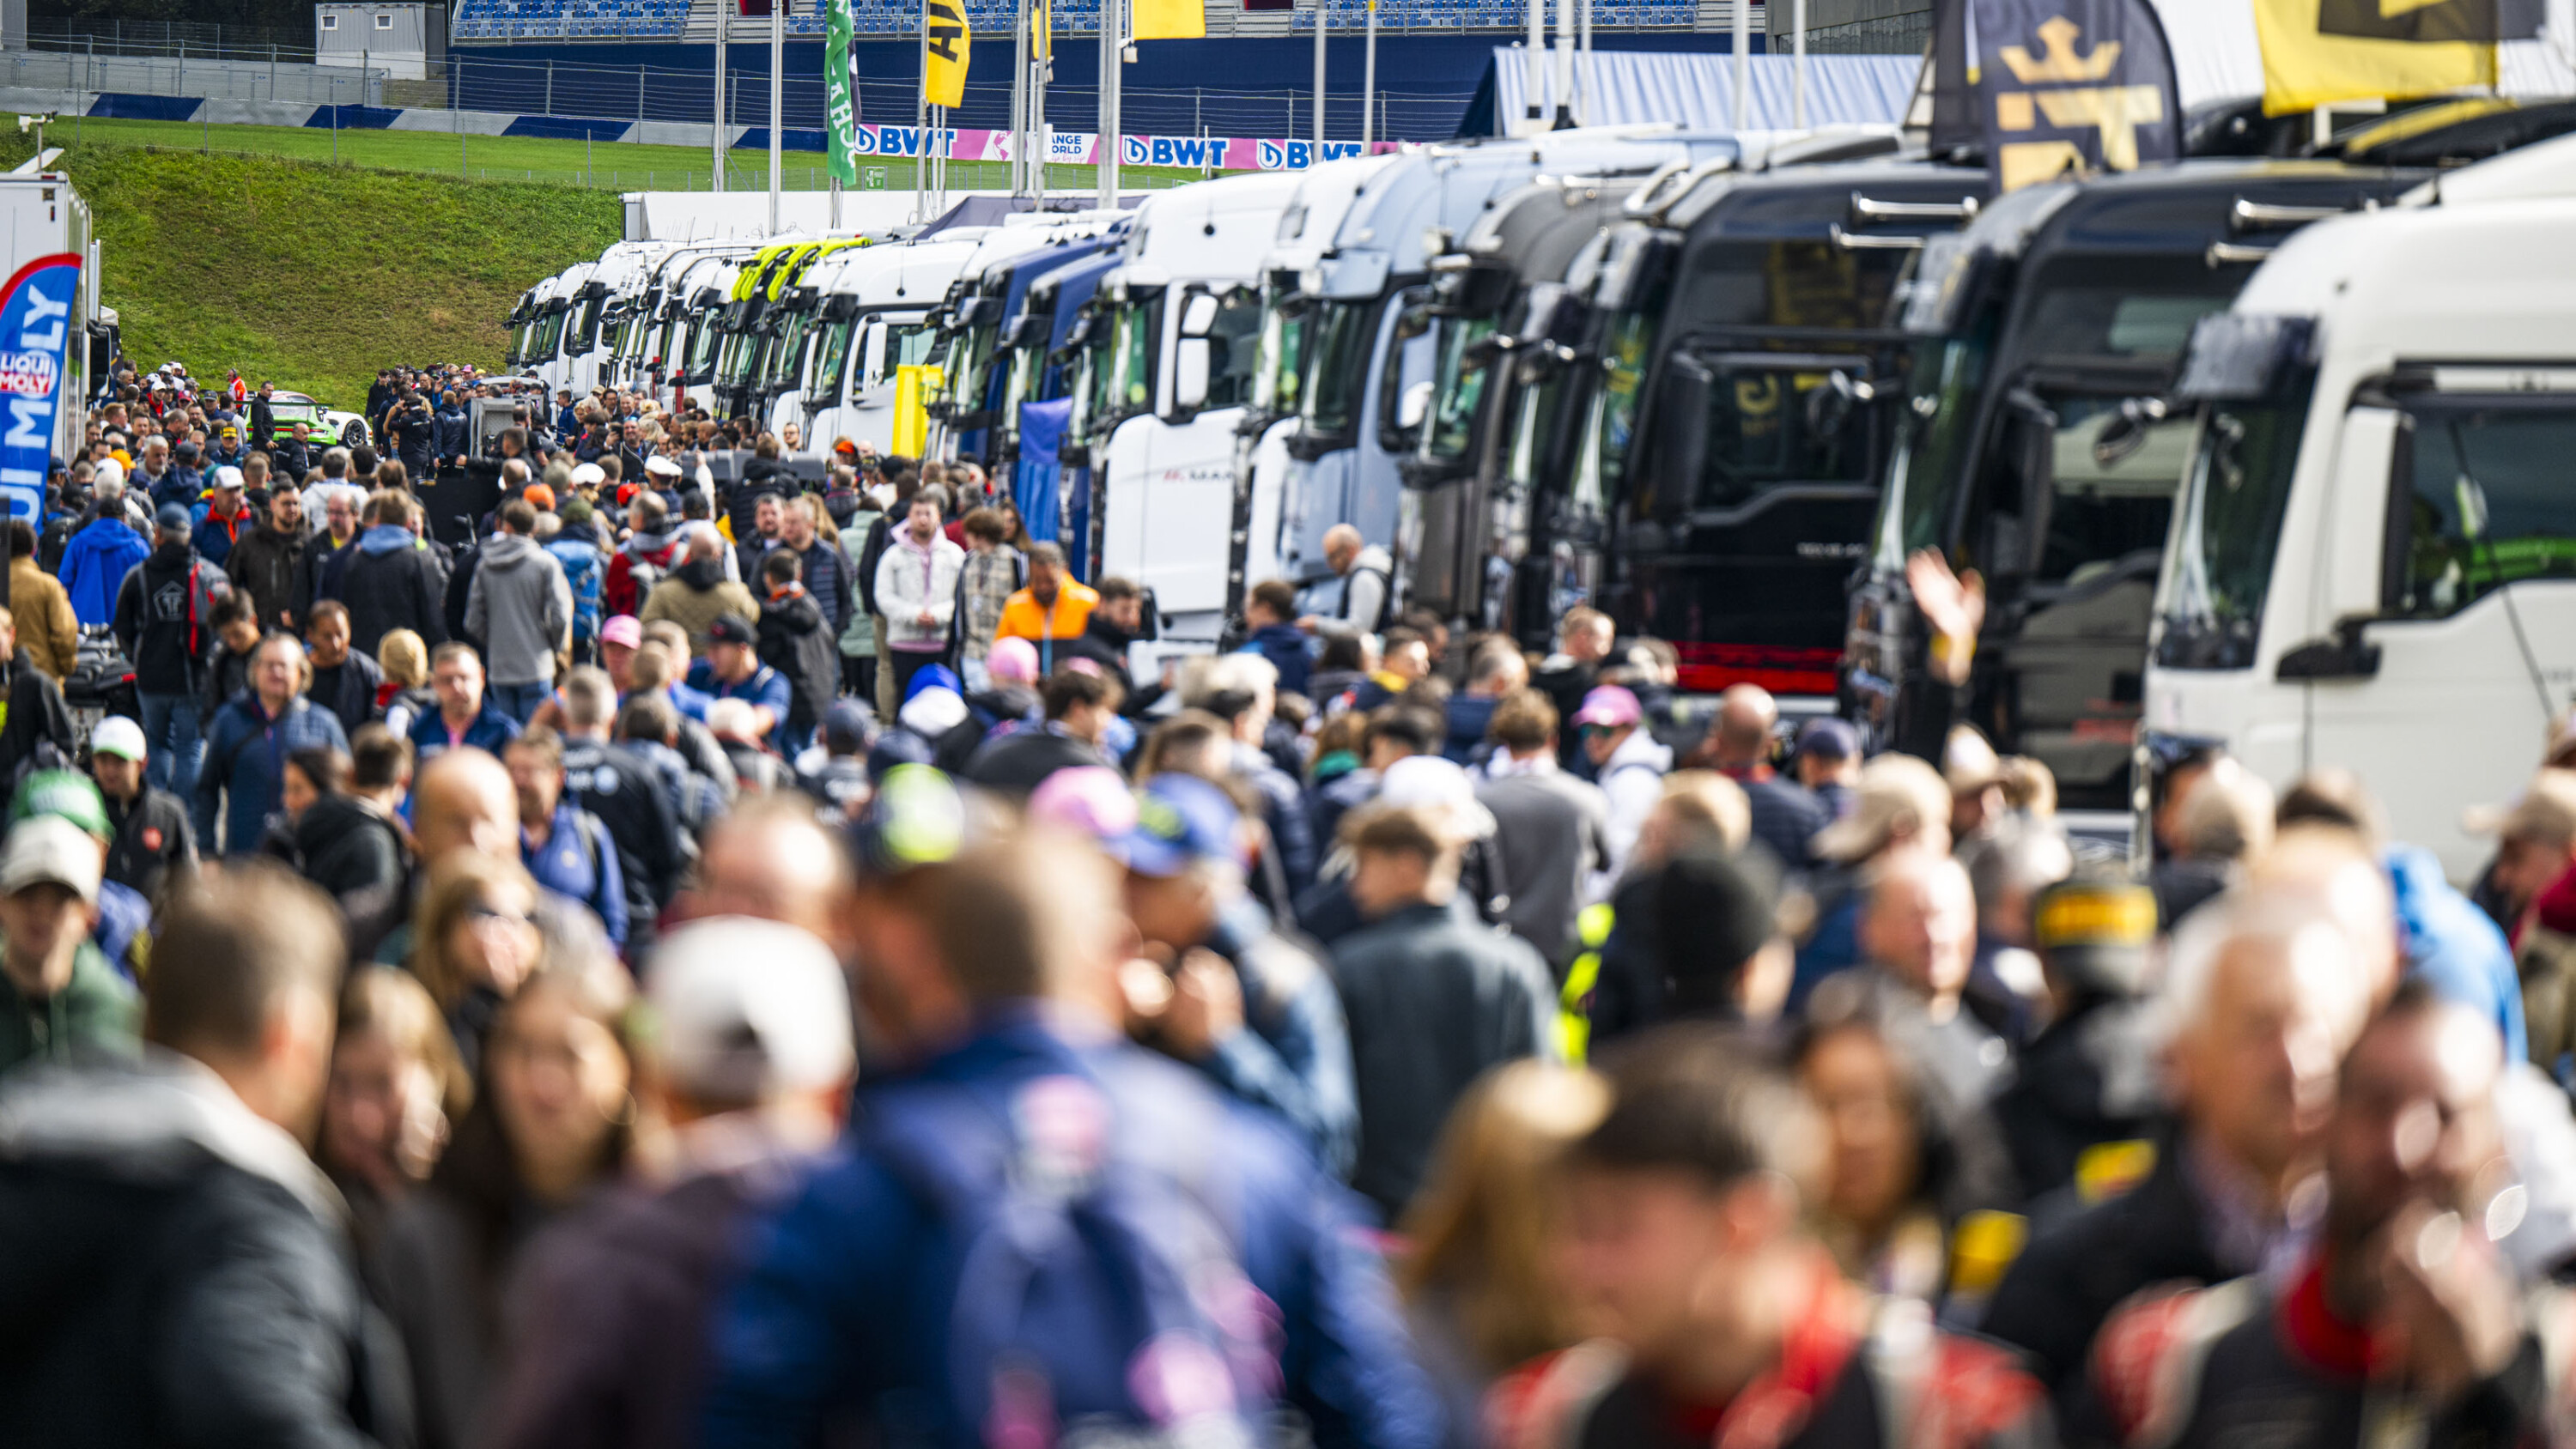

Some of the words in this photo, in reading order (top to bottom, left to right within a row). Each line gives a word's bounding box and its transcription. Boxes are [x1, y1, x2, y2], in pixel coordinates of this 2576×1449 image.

[880, 127, 956, 156] BWT
[1152, 138, 1226, 167] BWT
[0, 353, 52, 375] LIQUI
[0, 373, 50, 394] MOLY
